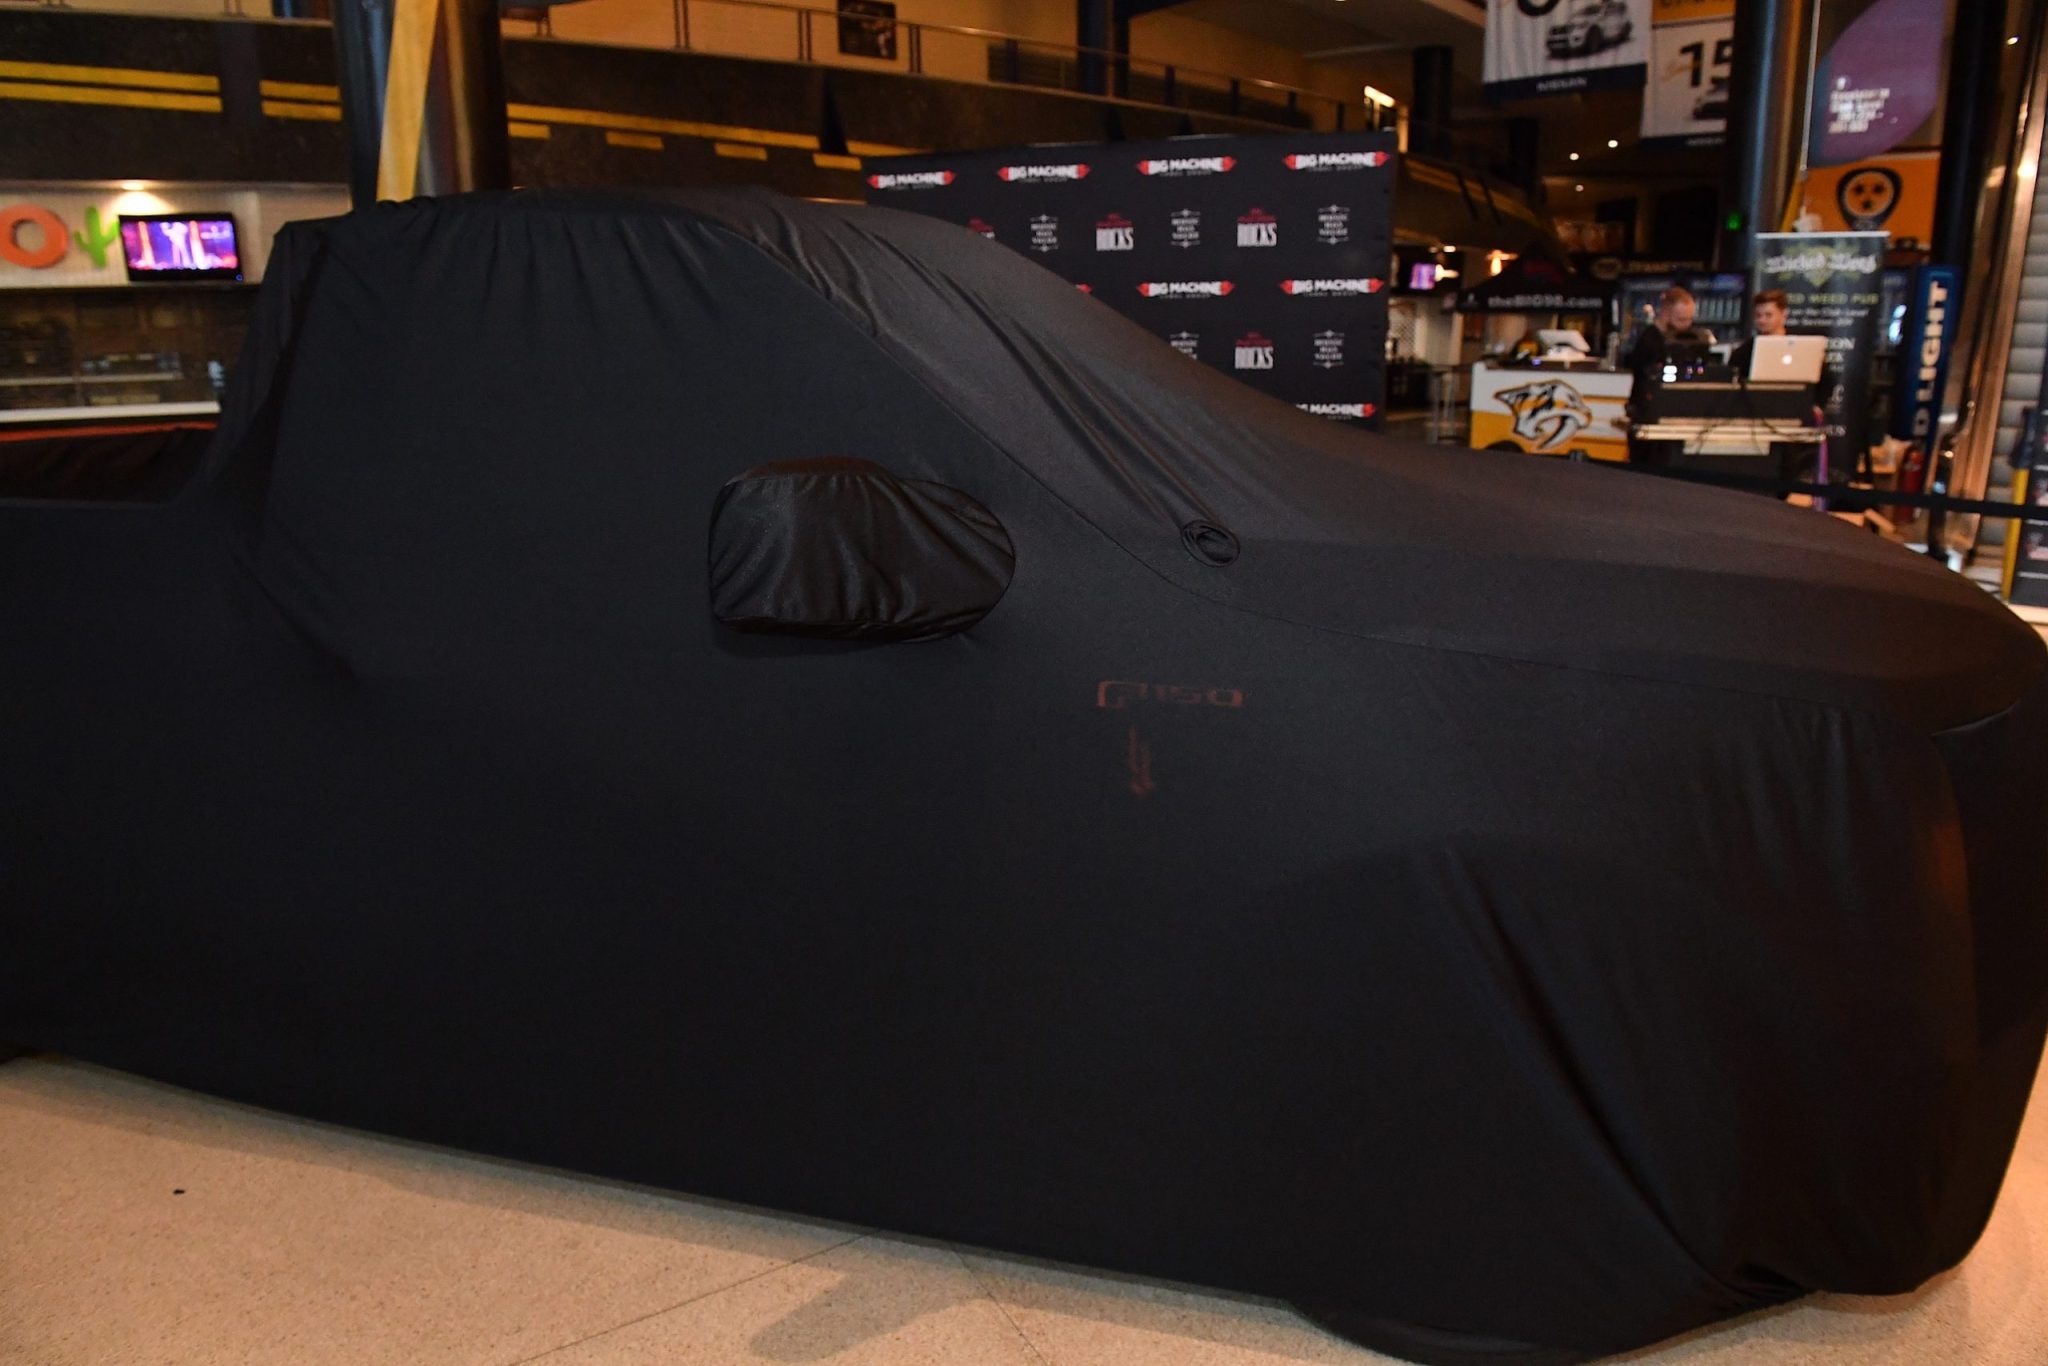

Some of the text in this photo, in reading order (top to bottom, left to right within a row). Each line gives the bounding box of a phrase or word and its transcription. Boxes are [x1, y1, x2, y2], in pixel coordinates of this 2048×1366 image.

[1148, 157, 1223, 175] BIG MACHINE
[1296, 152, 1376, 170] BIG MACHINE
[878, 171, 944, 189] BIG MACHINE
[1008, 165, 1077, 181] BIG MACHINE
[1149, 281, 1222, 296] BIG MACHINE
[1292, 279, 1369, 295] BIG MACHINE
[1916, 280, 1948, 402] LIGHT
[1310, 403, 1365, 417] MACHINE
